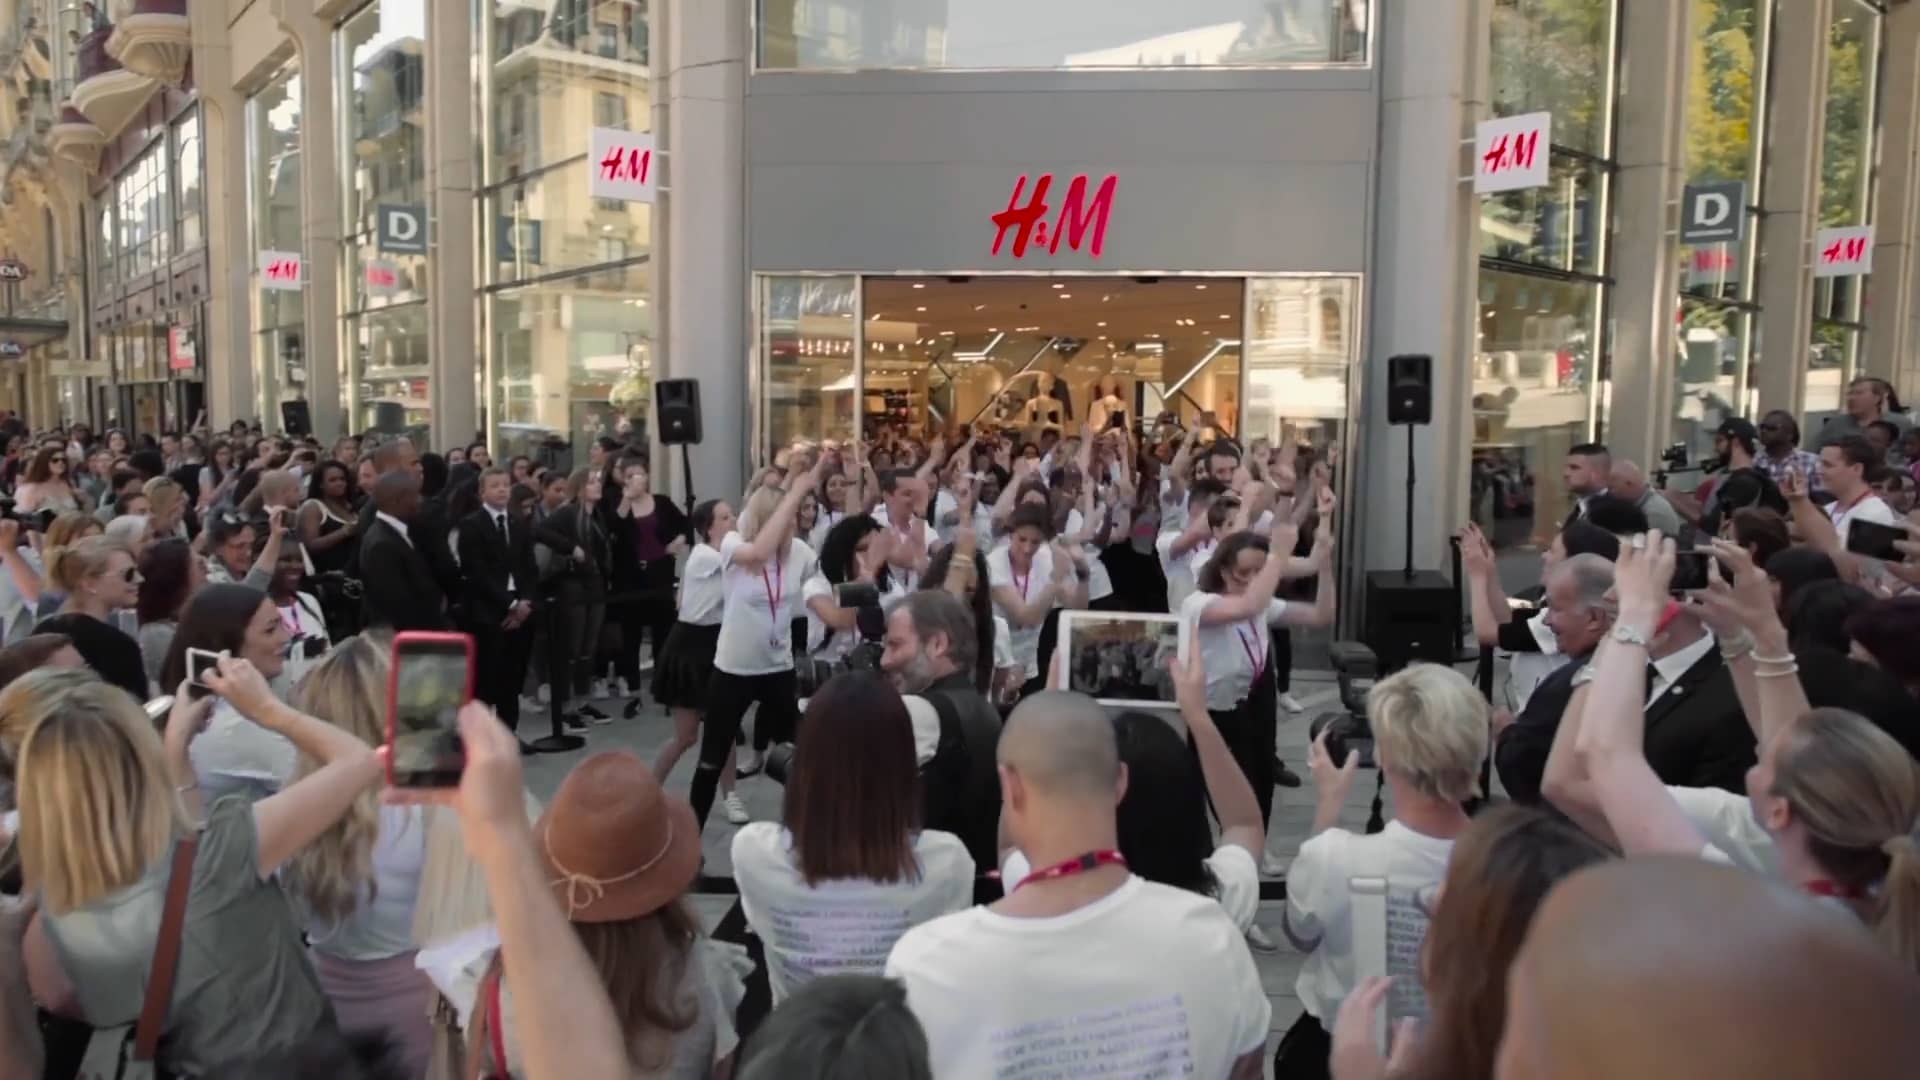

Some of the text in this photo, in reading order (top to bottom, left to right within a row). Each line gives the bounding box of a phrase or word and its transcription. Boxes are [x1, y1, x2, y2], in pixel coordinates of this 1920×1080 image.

[600, 146, 651, 186] H&M
[1482, 129, 1539, 174] H&M
[389, 211, 418, 240] D
[989, 172, 1119, 260] H&M
[1694, 193, 1730, 226] D
